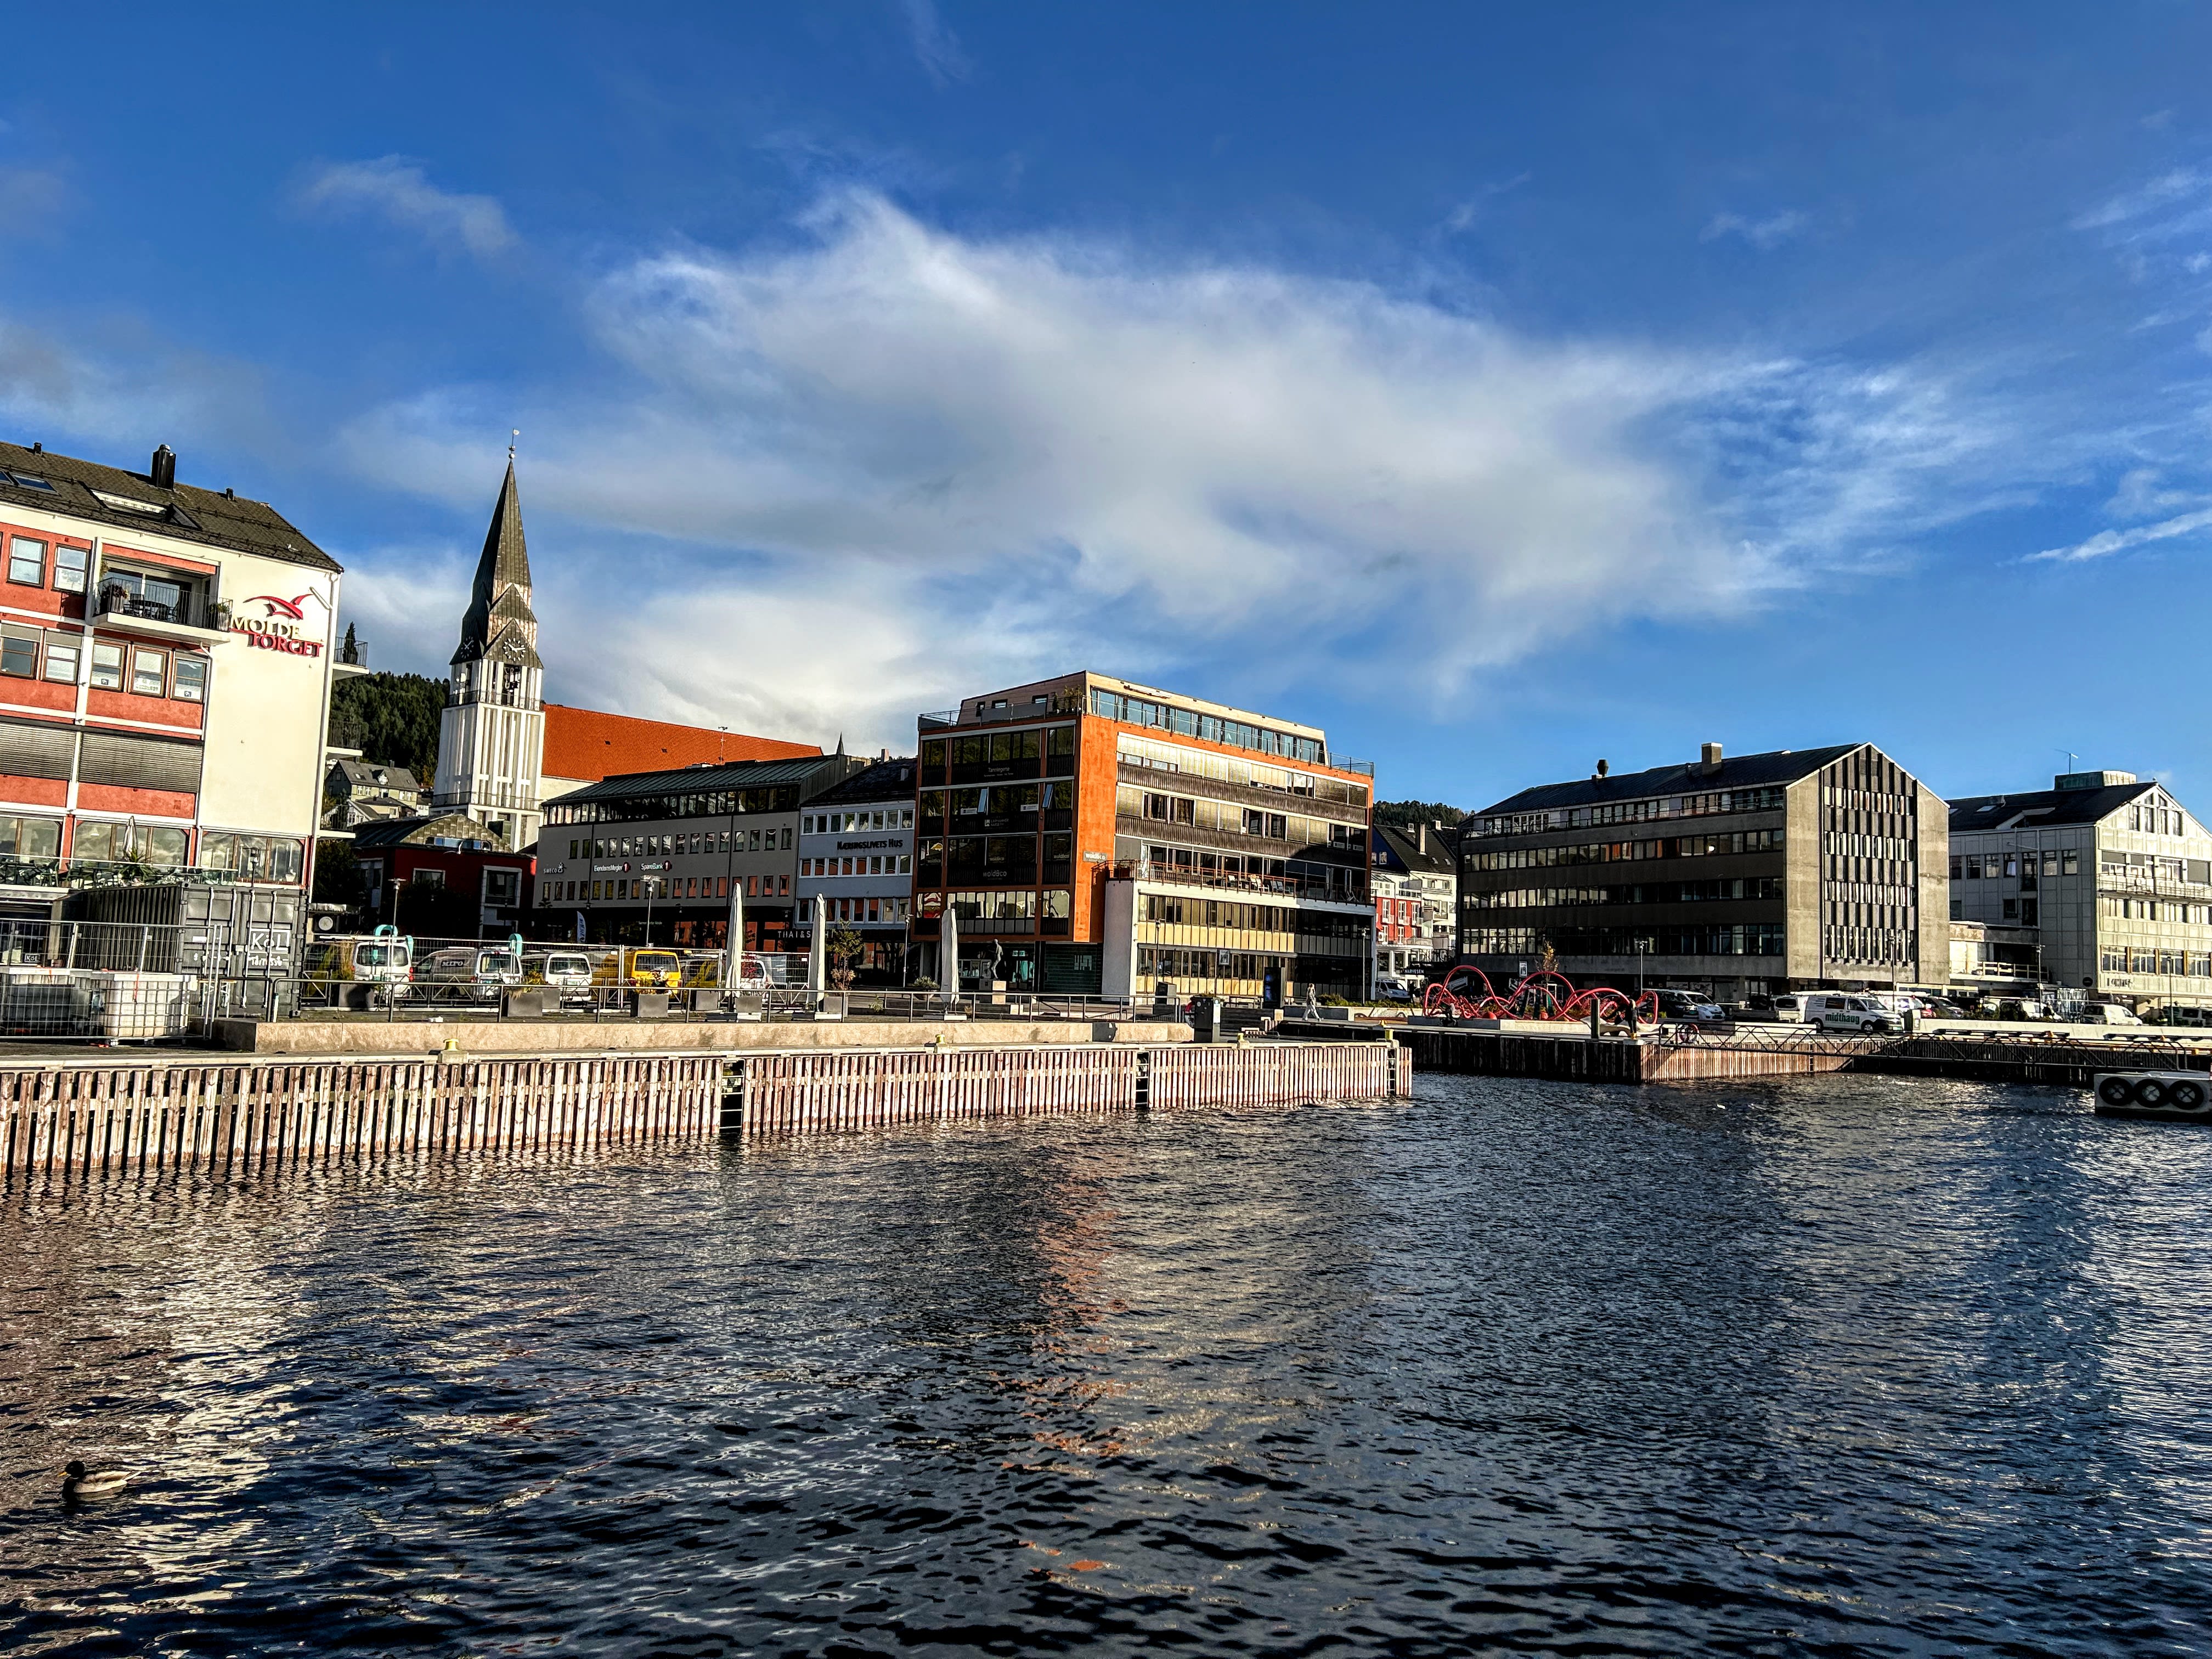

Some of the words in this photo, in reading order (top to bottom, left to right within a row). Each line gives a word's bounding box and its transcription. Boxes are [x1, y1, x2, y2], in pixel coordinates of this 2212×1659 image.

[229, 616, 301, 637] MOLDE
[249, 634, 324, 657] TORGET
[888, 839, 903, 848] HUS
[641, 862, 663, 871] SpareBank
[1825, 1013, 1859, 1024] midthaug
